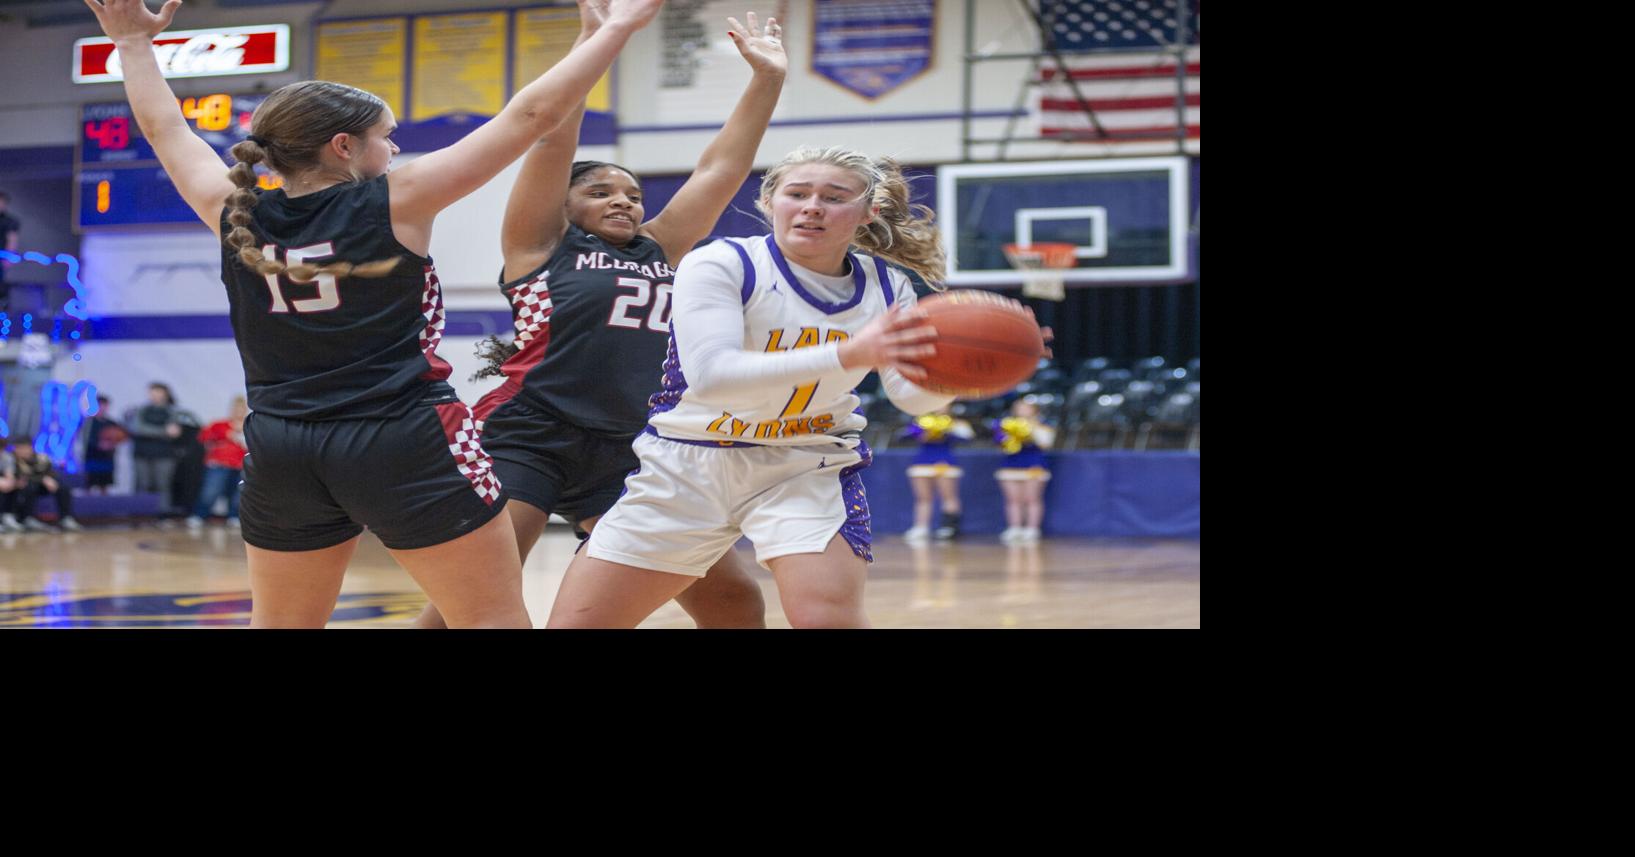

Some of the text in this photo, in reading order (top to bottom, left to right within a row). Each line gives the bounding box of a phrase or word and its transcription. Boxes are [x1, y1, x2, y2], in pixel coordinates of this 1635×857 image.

[85, 116, 129, 149] 48
[260, 240, 341, 315] 15
[607, 275, 674, 333] 20
[764, 326, 853, 353] LAD
[777, 377, 821, 419] 1
